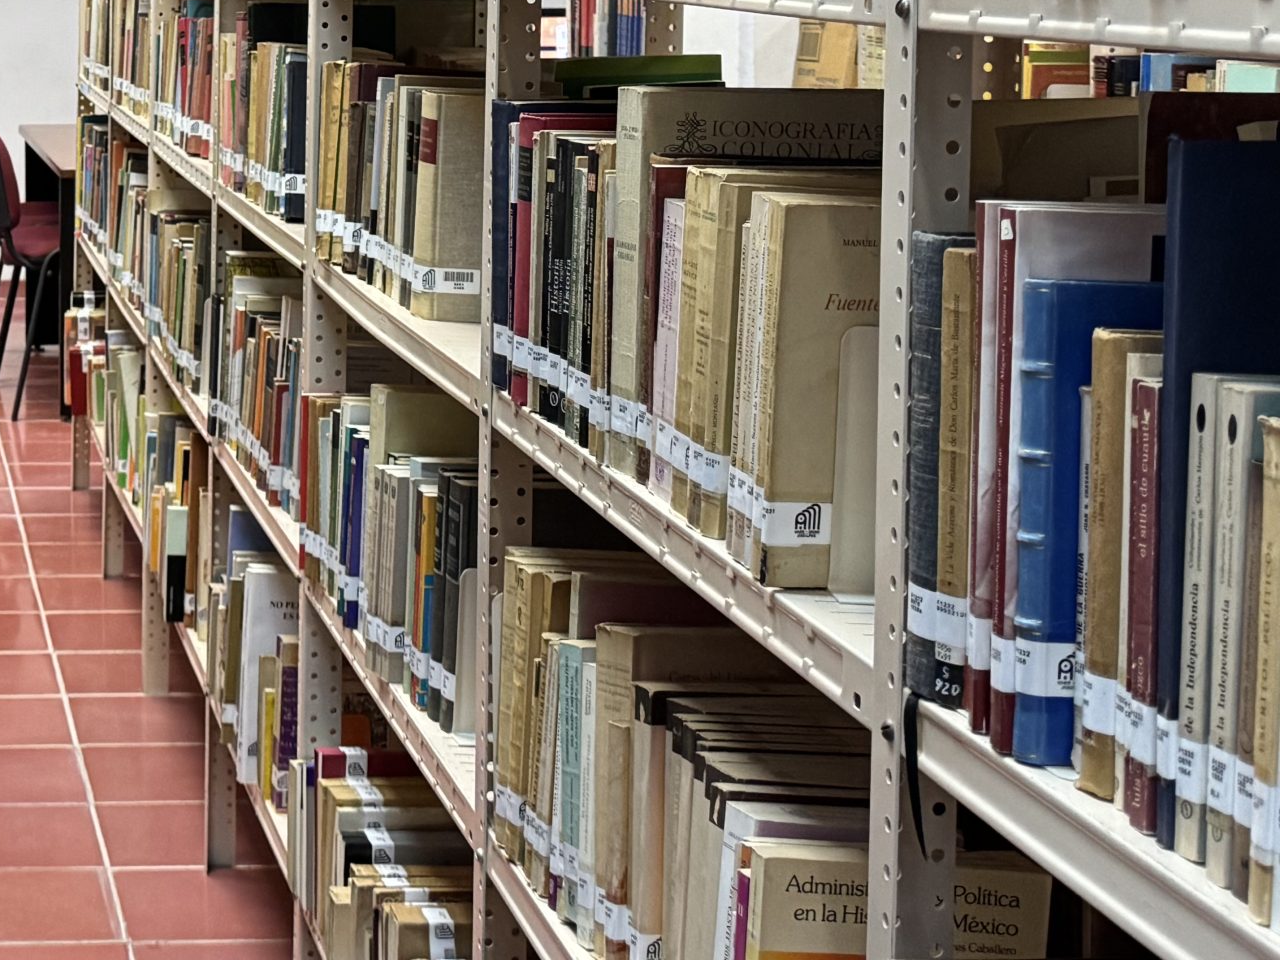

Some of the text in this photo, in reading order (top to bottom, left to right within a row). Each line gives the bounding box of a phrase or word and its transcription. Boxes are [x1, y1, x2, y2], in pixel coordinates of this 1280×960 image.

[712, 120, 870, 140] ICONOGRAFIA
[721, 141, 860, 159] COLONIAL
[843, 239, 879, 247] MANUEL
[949, 385, 958, 411] Carlos
[950, 435, 957, 447] de
[1138, 478, 1148, 558] el sitio de
[1076, 602, 1084, 615] LA
[1184, 583, 1201, 690] Independencia
[1216, 599, 1230, 730] la Independencia
[935, 678, 961, 696] 920
[1182, 696, 1194, 711] la
[1181, 716, 1194, 734] de
[953, 885, 1020, 909] Política
[725, 906, 733, 942] HASTA
[793, 908, 818, 922] en
[821, 905, 838, 923] la
[953, 913, 1019, 937] México
